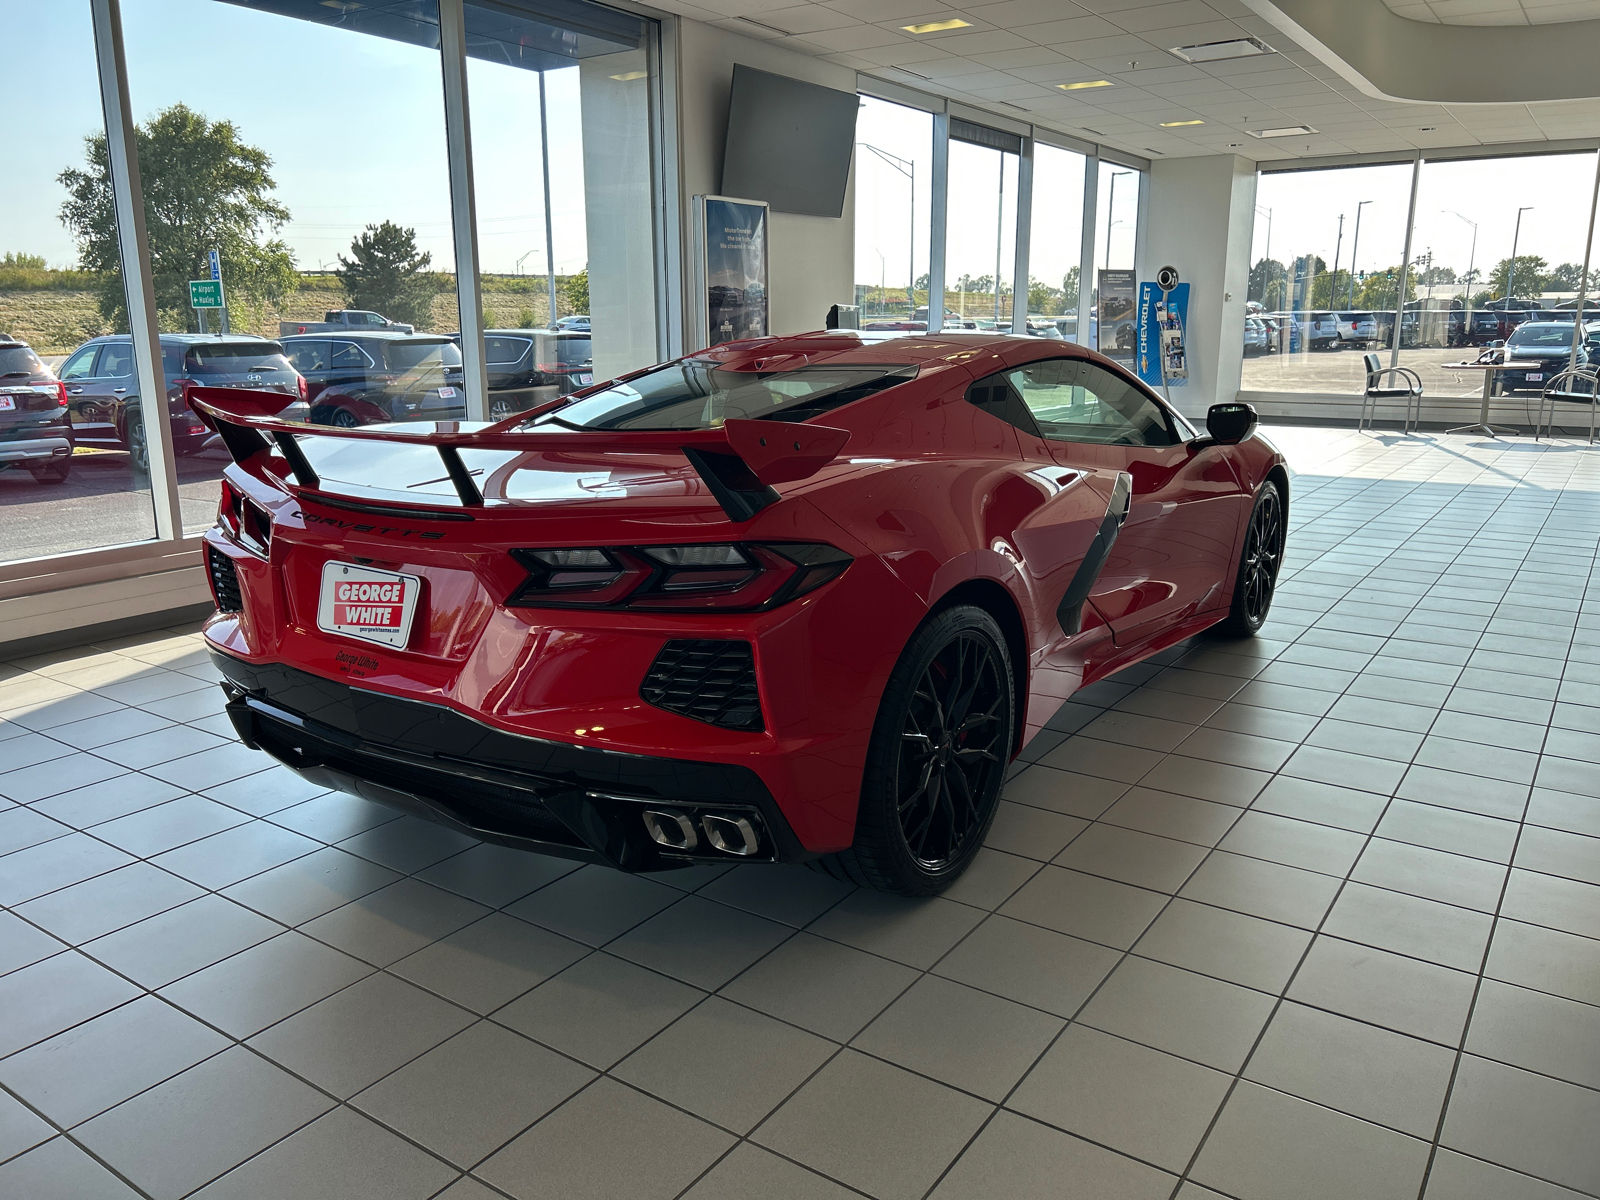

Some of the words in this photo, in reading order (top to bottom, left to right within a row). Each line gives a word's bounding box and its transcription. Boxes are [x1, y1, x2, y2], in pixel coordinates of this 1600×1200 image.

[210, 252, 218, 270] H
[198, 285, 215, 294] Airport
[199, 295, 214, 305] Huxley
[1141, 286, 1151, 353] CHEVROLET
[290, 510, 447, 540] CORVETTE
[338, 584, 401, 602] GEORGE
[345, 606, 392, 625] WHITE
[335, 650, 358, 667] George
[357, 655, 379, 670] White
